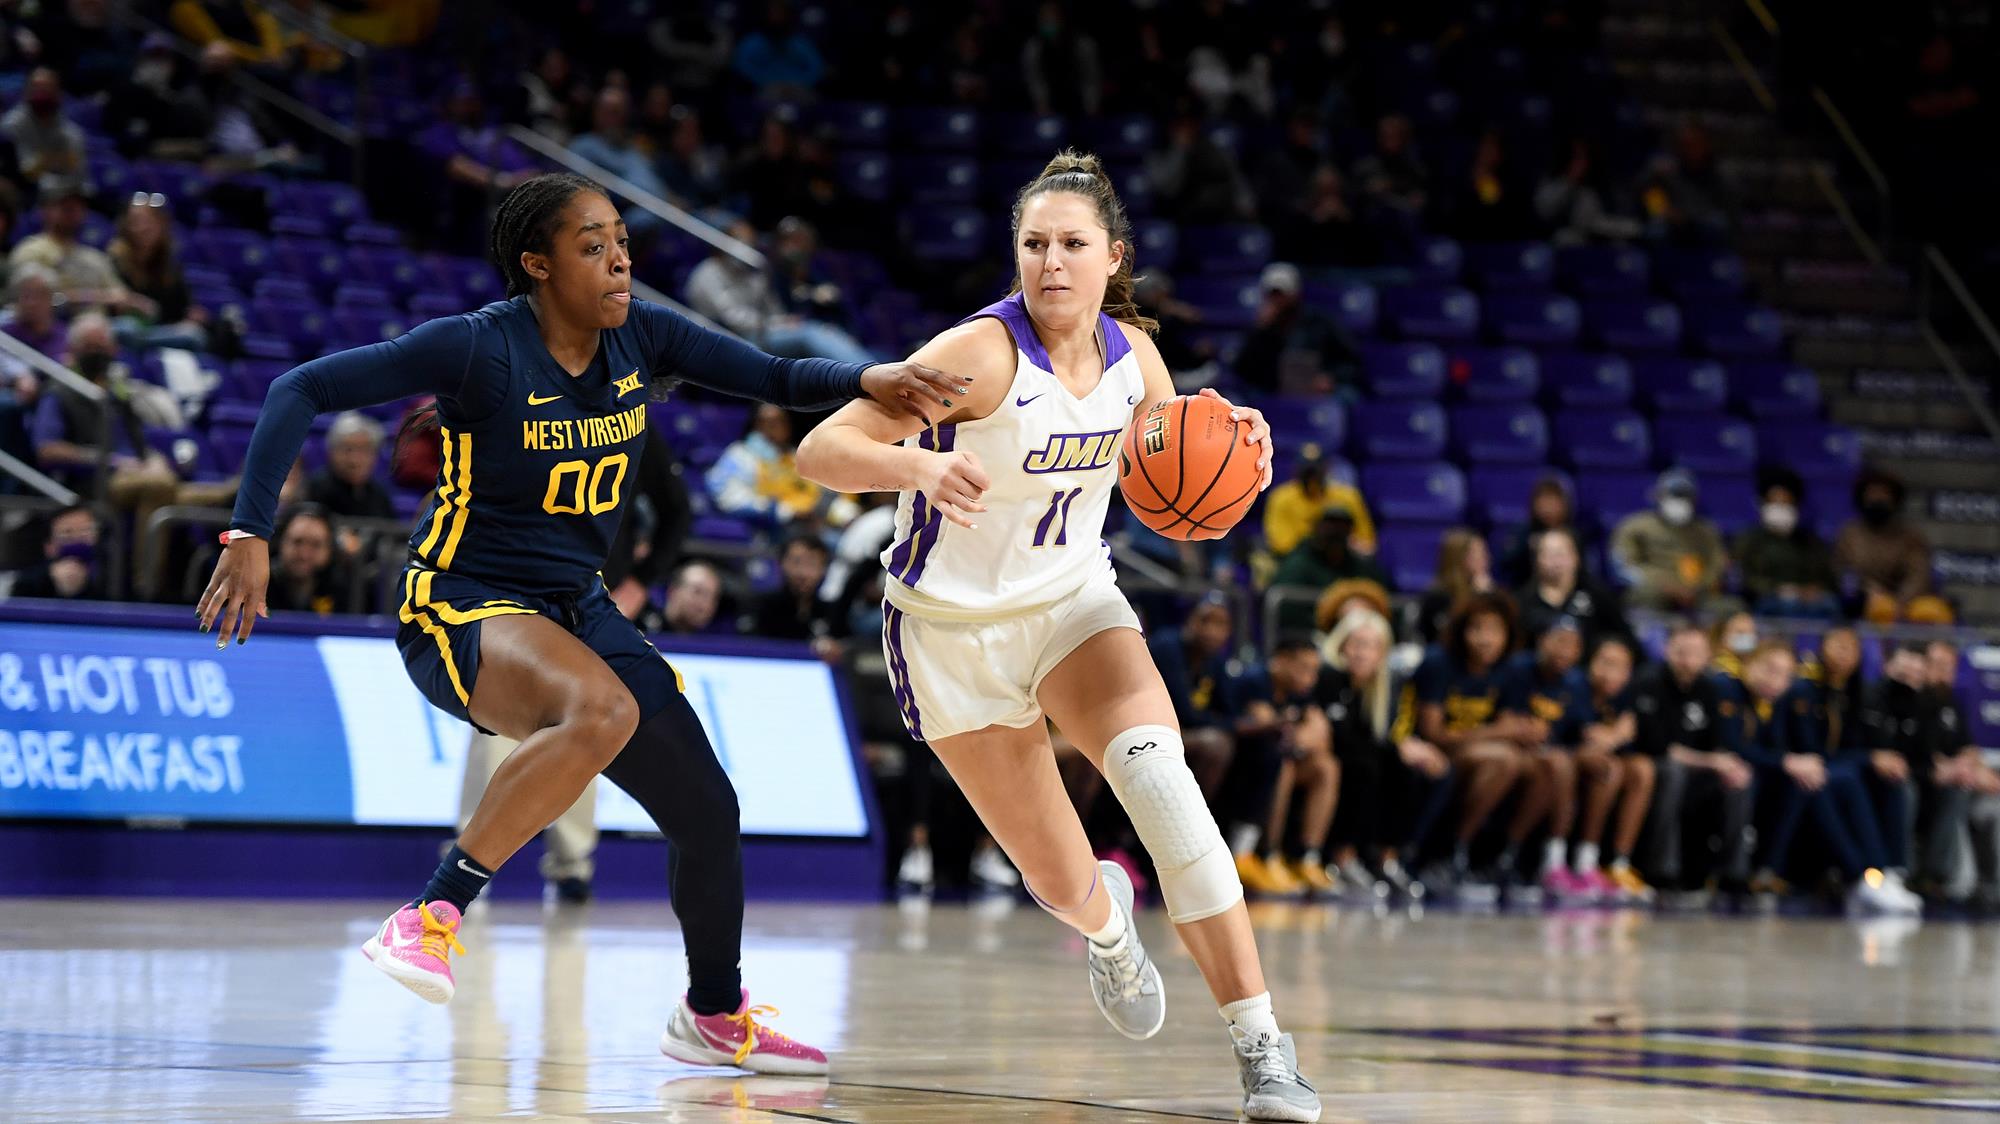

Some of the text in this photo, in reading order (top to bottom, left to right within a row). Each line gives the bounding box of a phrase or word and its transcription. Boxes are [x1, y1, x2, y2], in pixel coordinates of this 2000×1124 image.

[613, 369, 644, 398] XII
[523, 403, 646, 450] WEST VIRGINIA
[1023, 428, 1123, 474] JMU
[542, 452, 629, 516] 00
[1032, 485, 1084, 547] 11
[0, 652, 235, 718] & HOT TUB
[0, 728, 245, 793] BREAKFAST
